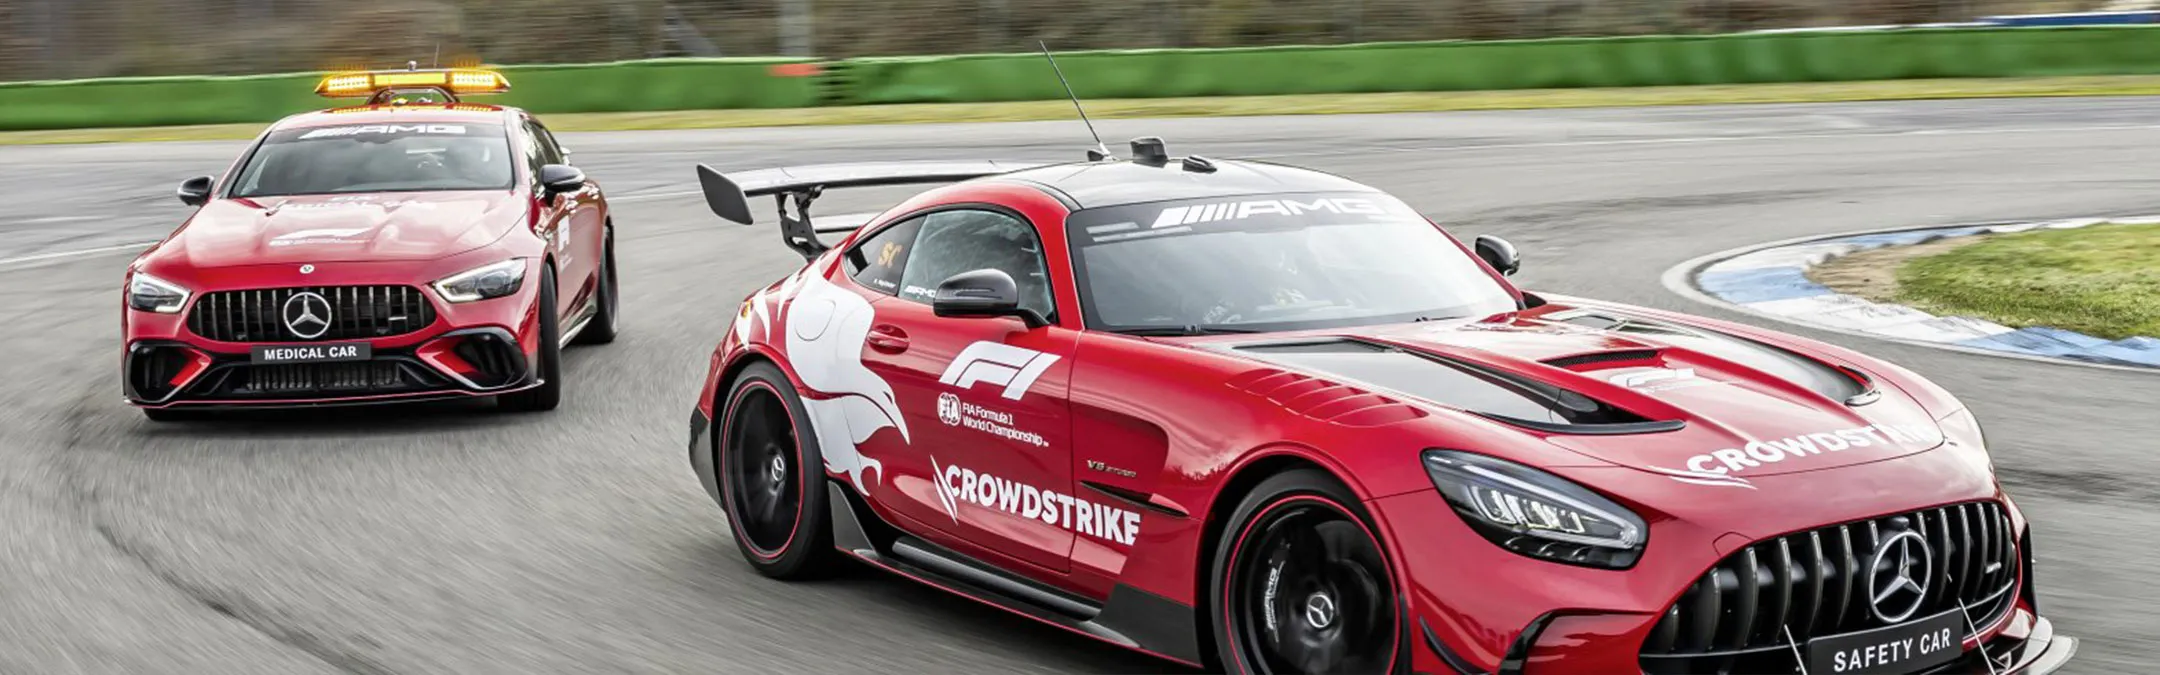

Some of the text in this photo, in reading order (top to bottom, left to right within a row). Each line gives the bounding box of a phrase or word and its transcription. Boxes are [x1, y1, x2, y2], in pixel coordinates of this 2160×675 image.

[878, 241, 903, 268] SC
[264, 345, 357, 360] MEDICAL CAR
[938, 340, 1062, 401] F1
[962, 402, 976, 416] FIA
[975, 405, 1009, 425] Formula
[962, 415, 1043, 446] World Championship
[944, 464, 1141, 546] CROWDSTRIKE
[1834, 627, 1951, 672] SAFETY CAR
